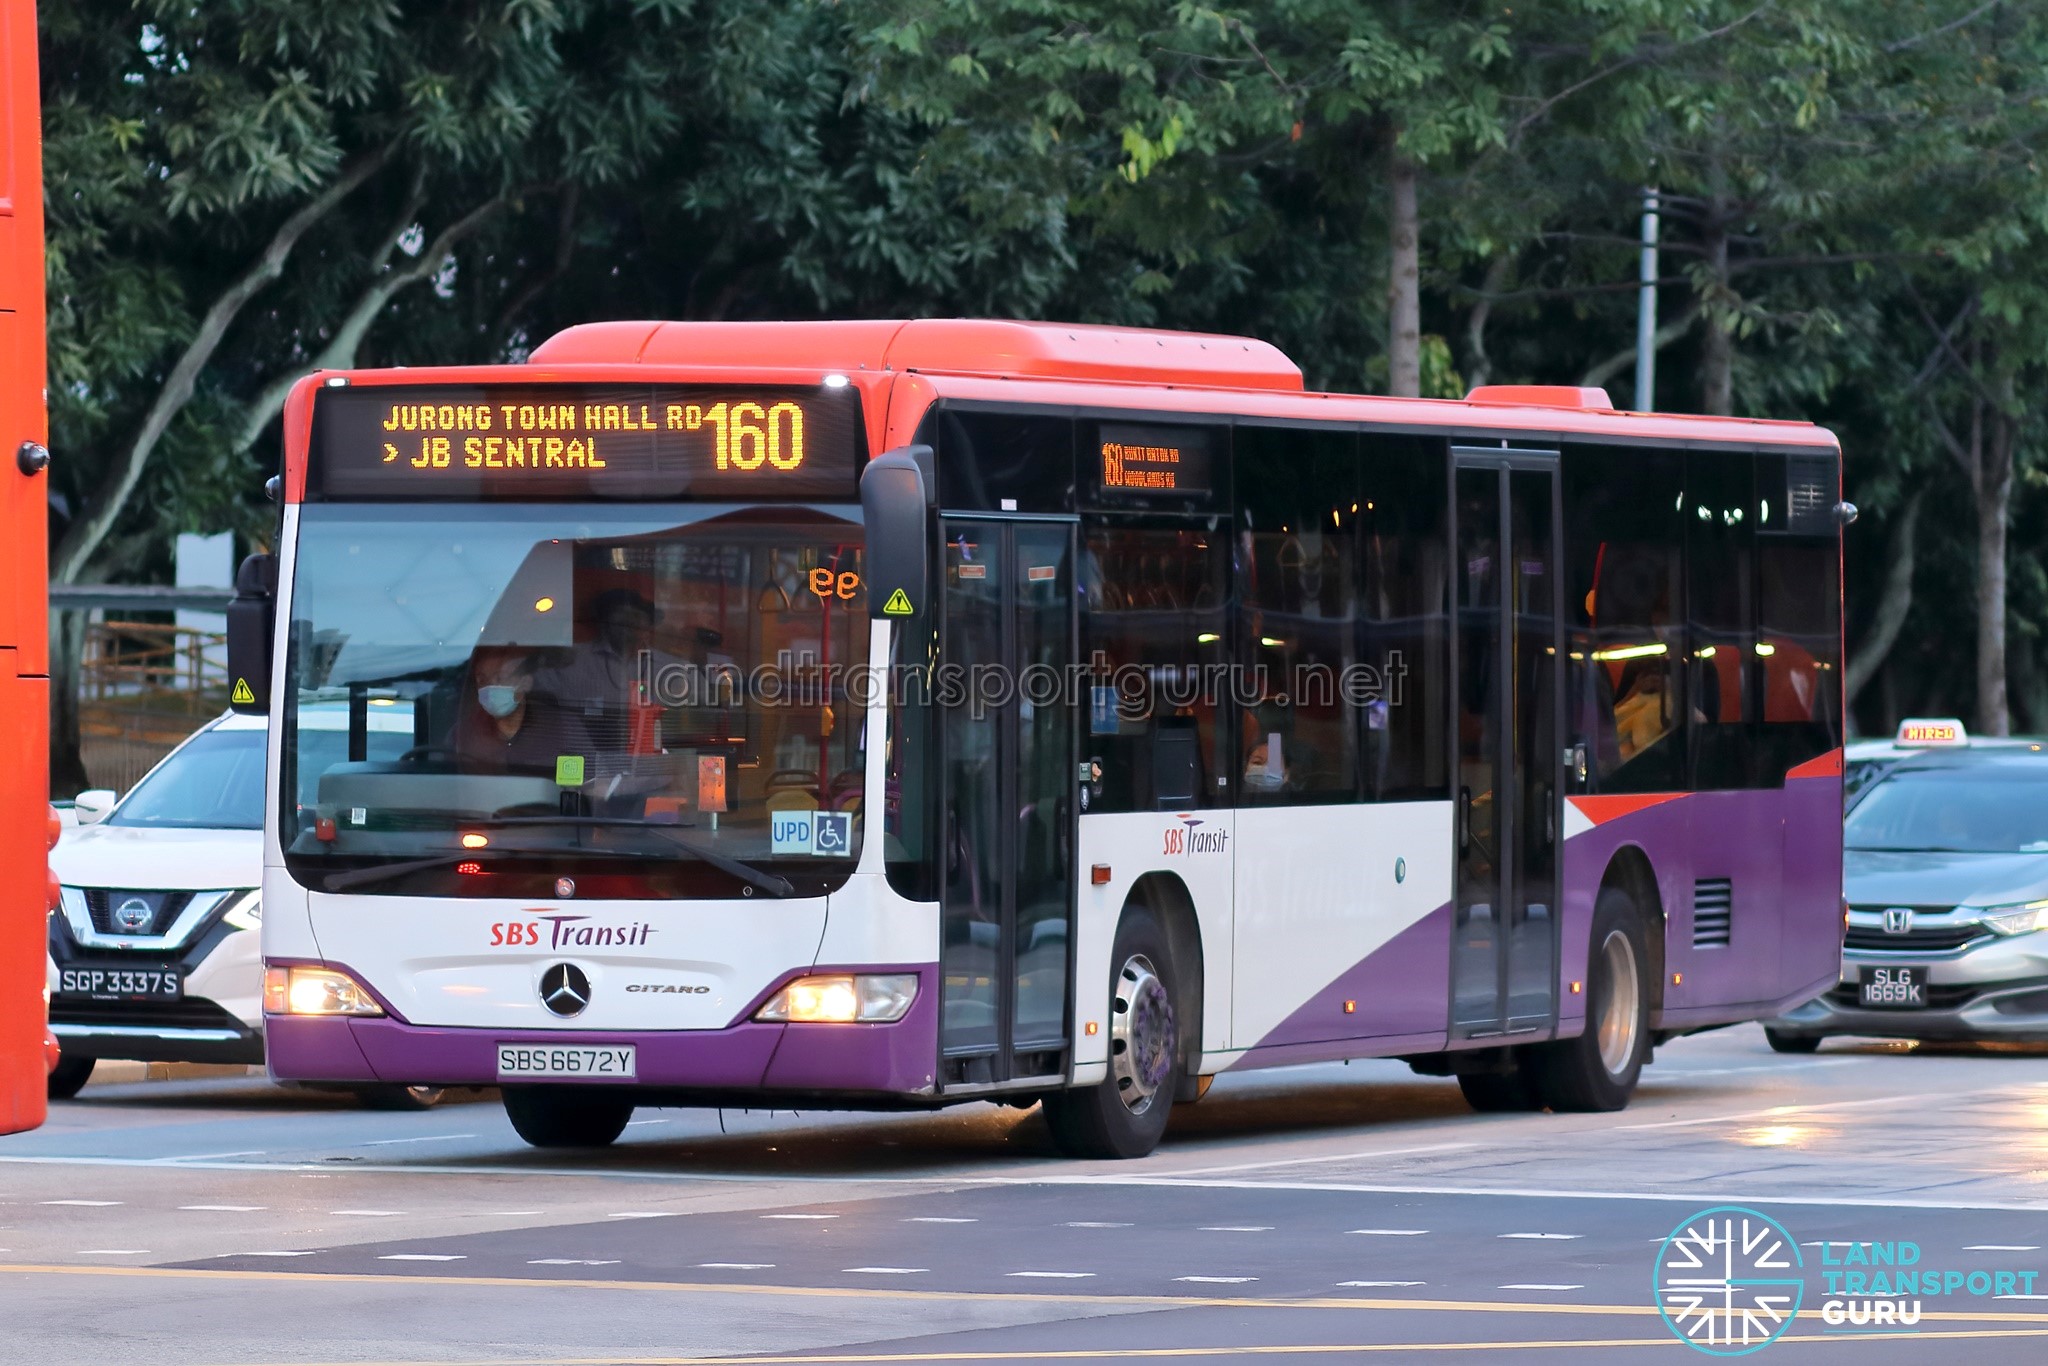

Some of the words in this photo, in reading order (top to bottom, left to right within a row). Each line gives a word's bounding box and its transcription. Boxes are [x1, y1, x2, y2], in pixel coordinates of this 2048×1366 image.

[384, 405, 493, 431] JURONG
[500, 405, 576, 431] TOWN
[584, 405, 658, 431] HALL
[667, 405, 702, 431] RD
[702, 402, 804, 473] 160
[410, 437, 451, 468] JB
[464, 436, 606, 468] SENTRAL
[1102, 442, 1123, 486] 160
[1908, 727, 1955, 741] HIRED
[773, 821, 810, 843] UPD
[1163, 828, 1184, 855] SBS
[1182, 820, 1229, 857] Transit
[490, 922, 539, 946] SBS
[537, 915, 659, 951] Transit
[625, 984, 710, 994] CITARO
[1874, 969, 1911, 985] SLG
[1865, 984, 1921, 1002] 1669K
[501, 1050, 631, 1072] SBS6672Y
